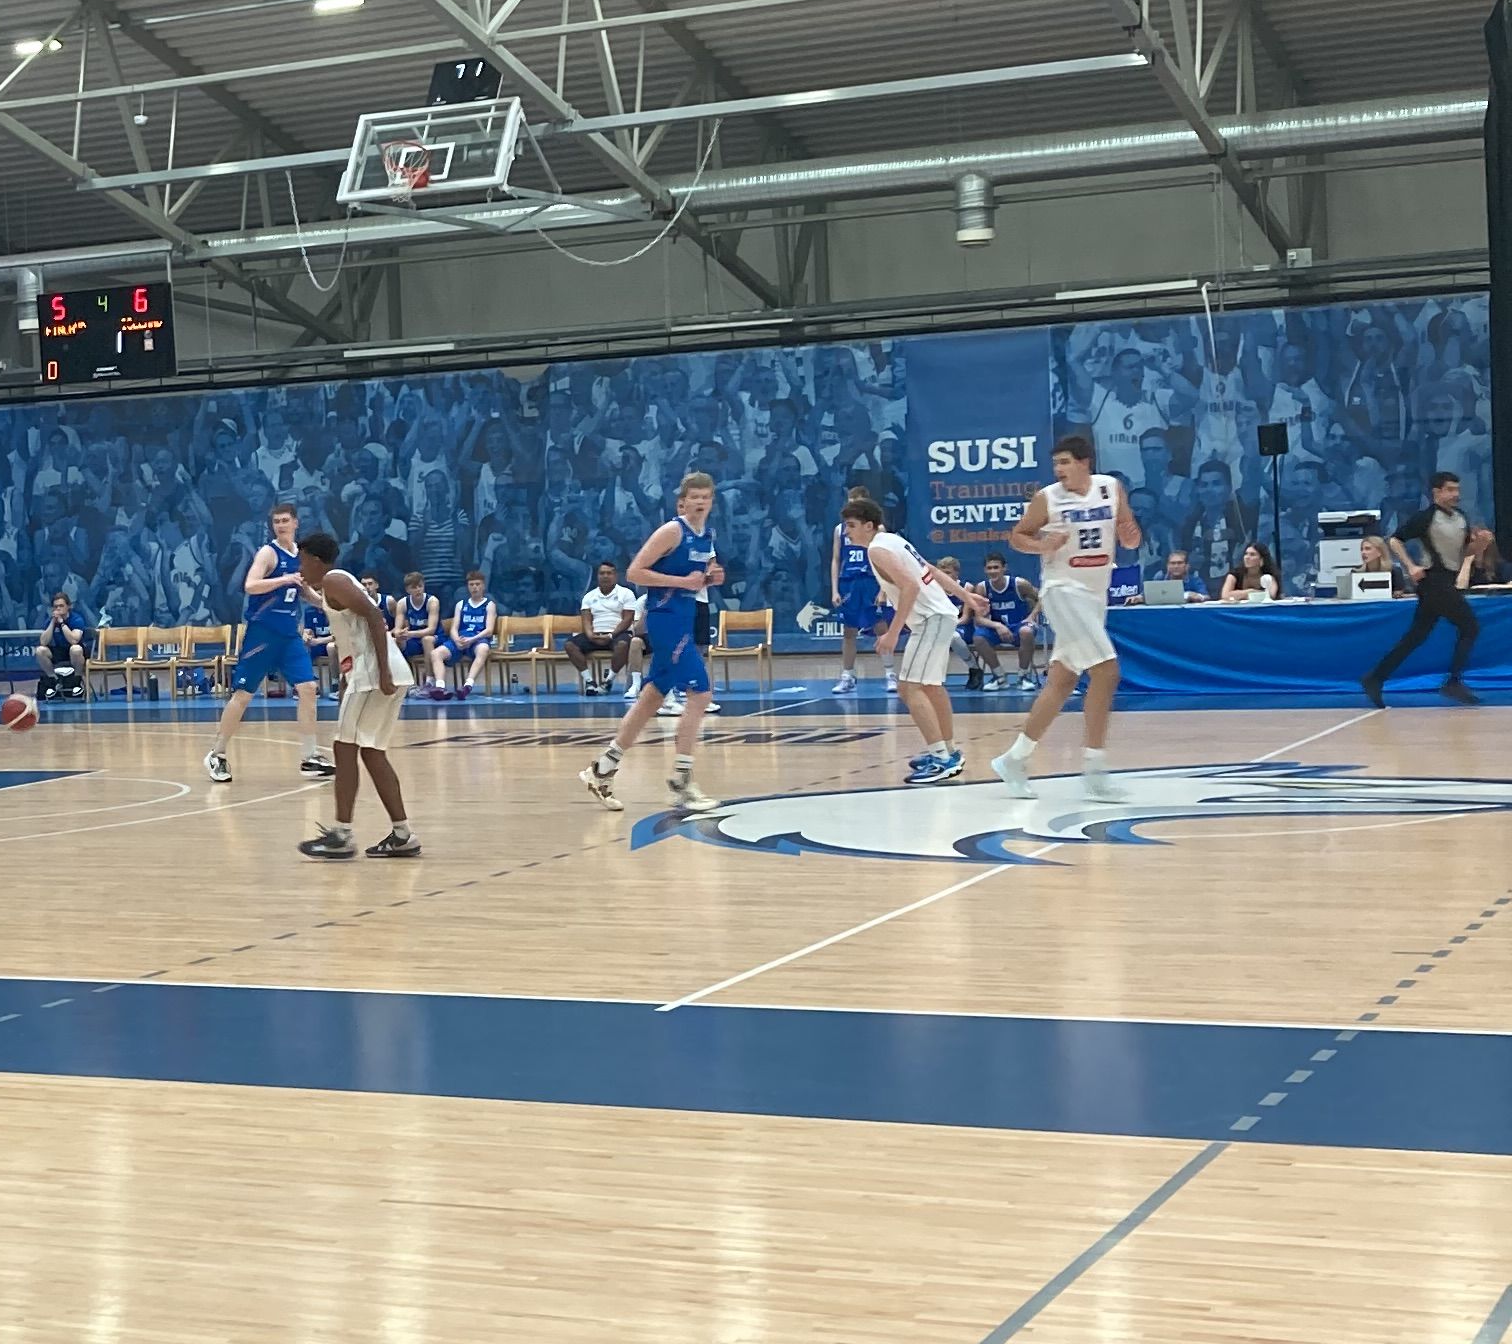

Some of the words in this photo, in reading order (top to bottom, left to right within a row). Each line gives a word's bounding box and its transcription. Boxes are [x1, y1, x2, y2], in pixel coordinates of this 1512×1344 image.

[51, 296, 66, 321] 5
[97, 295, 108, 313] 4
[135, 288, 148, 313] 6
[48, 361, 58, 380] 0
[928, 436, 1037, 473] SUSI
[849, 550, 864, 562] 20
